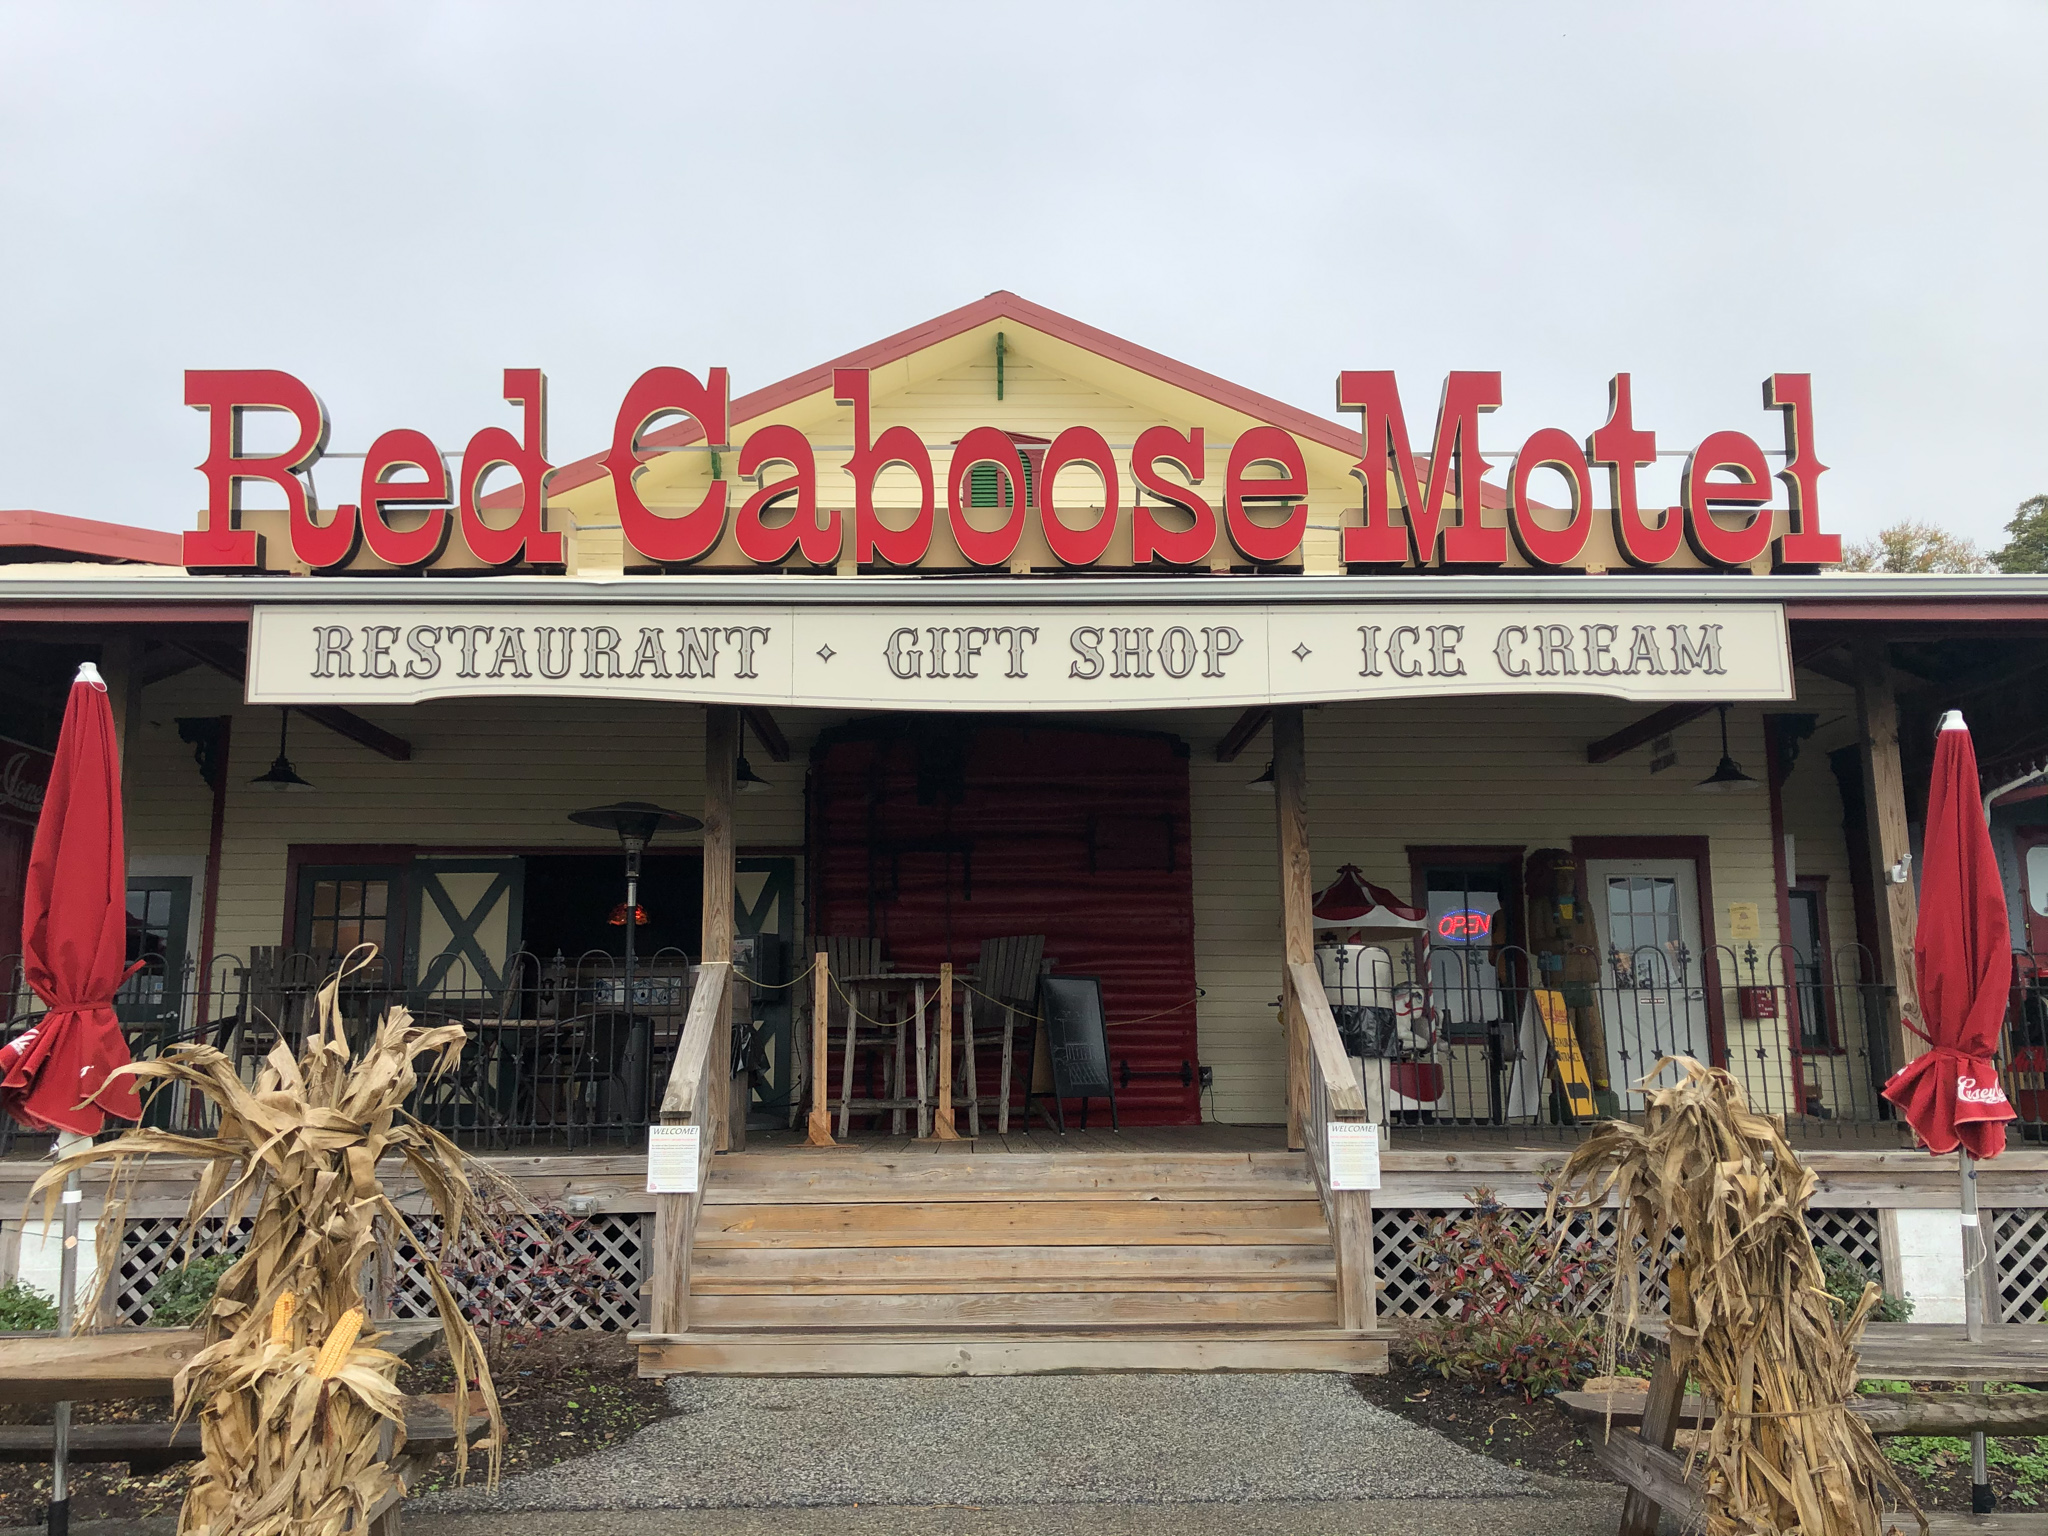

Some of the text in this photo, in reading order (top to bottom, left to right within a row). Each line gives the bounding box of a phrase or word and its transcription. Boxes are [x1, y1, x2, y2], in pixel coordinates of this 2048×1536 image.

[182, 366, 1842, 572] Red Caboose Motel
[310, 625, 771, 679] RESTAURANT
[883, 626, 1244, 679] GIFT SHOP
[1357, 624, 1727, 677] ICE CREAM
[3, 752, 43, 804] Jone
[1438, 914, 1491, 936] OPEN
[653, 1127, 698, 1135] WELCOME!
[1331, 1124, 1376, 1133] WELCOME!
